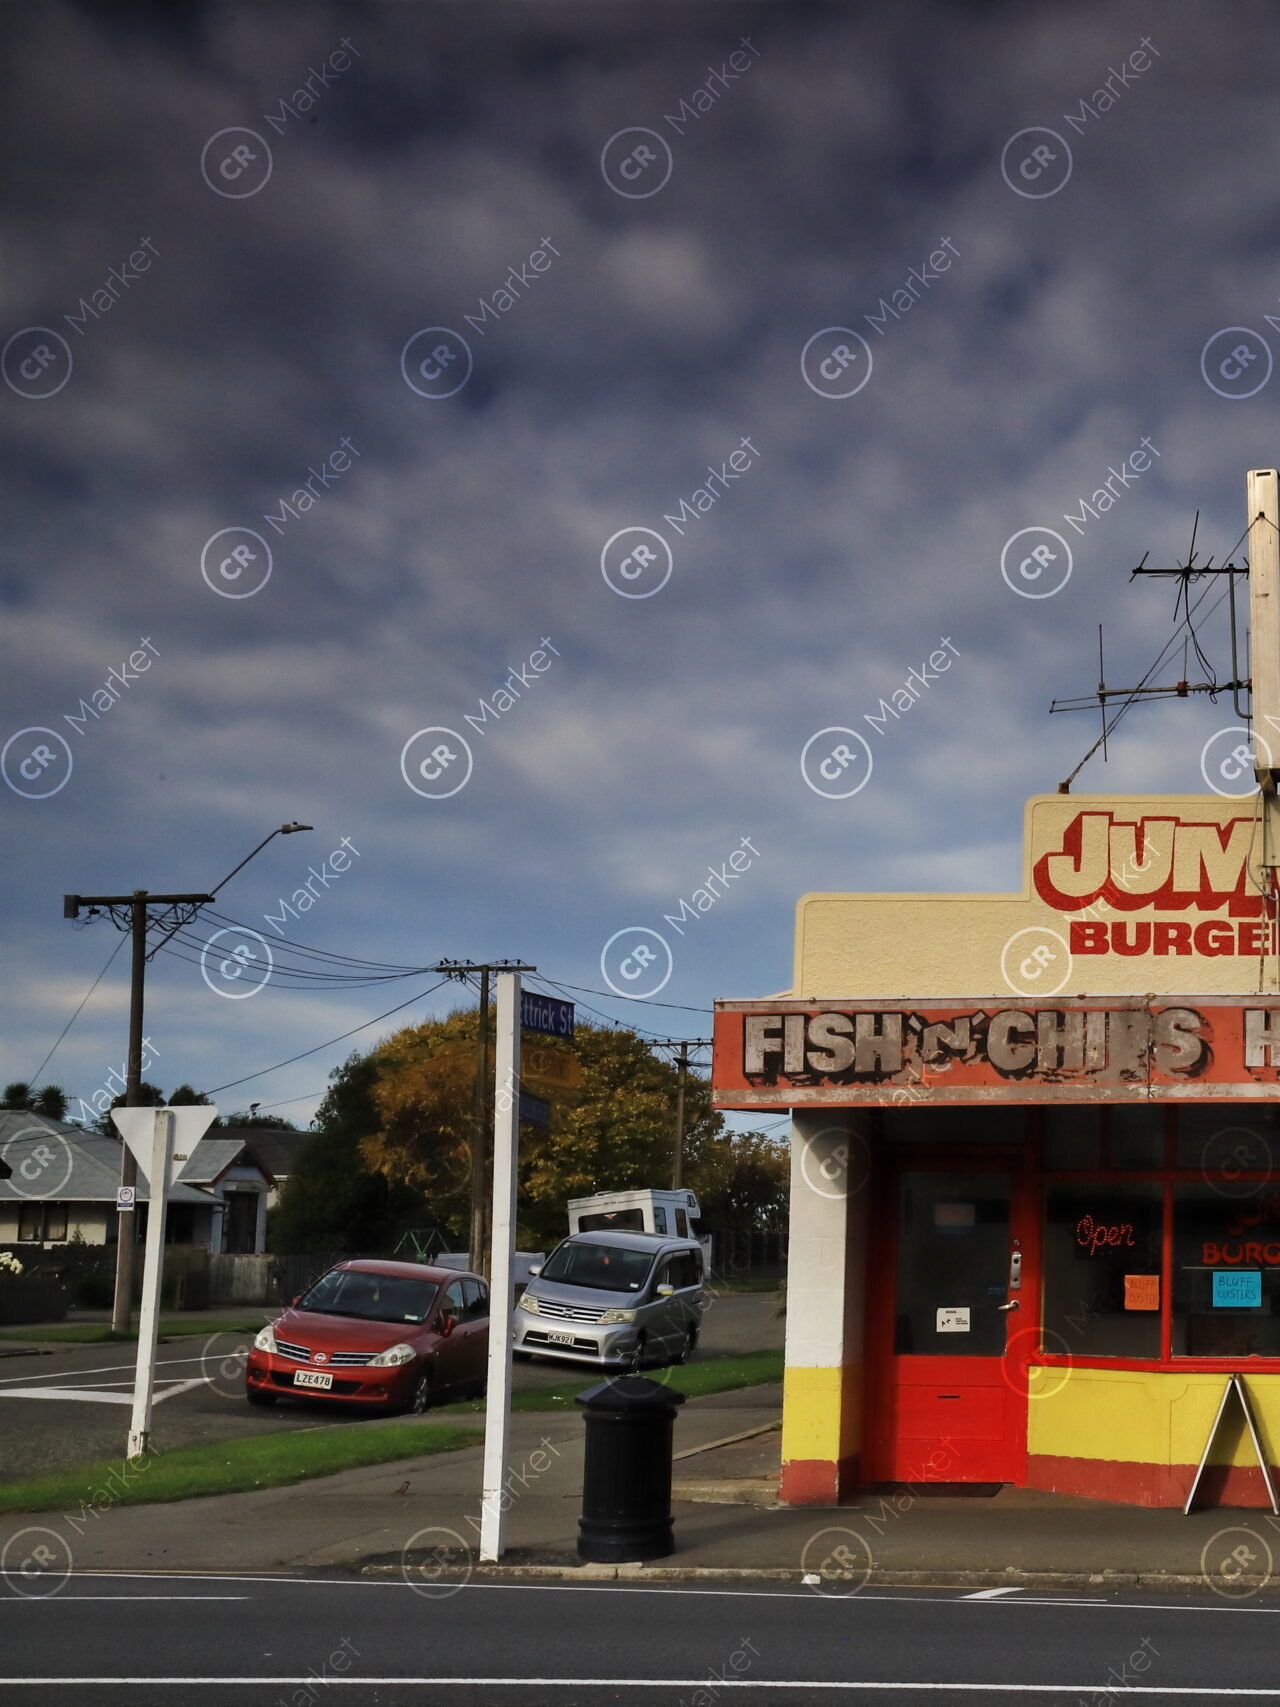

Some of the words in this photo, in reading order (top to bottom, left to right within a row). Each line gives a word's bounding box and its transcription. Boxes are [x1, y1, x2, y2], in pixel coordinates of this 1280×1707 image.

[519, 998, 556, 1032] ttrick
[559, 1006, 573, 1037] St
[743, 1011, 903, 1081] FISH
[987, 1007, 1214, 1081] CHIPS
[1076, 1213, 1136, 1256] Open
[1217, 1288, 1257, 1301] OYSTERS
[1218, 1275, 1254, 1288] BLUFF
[295, 1371, 332, 1387] LZE478
